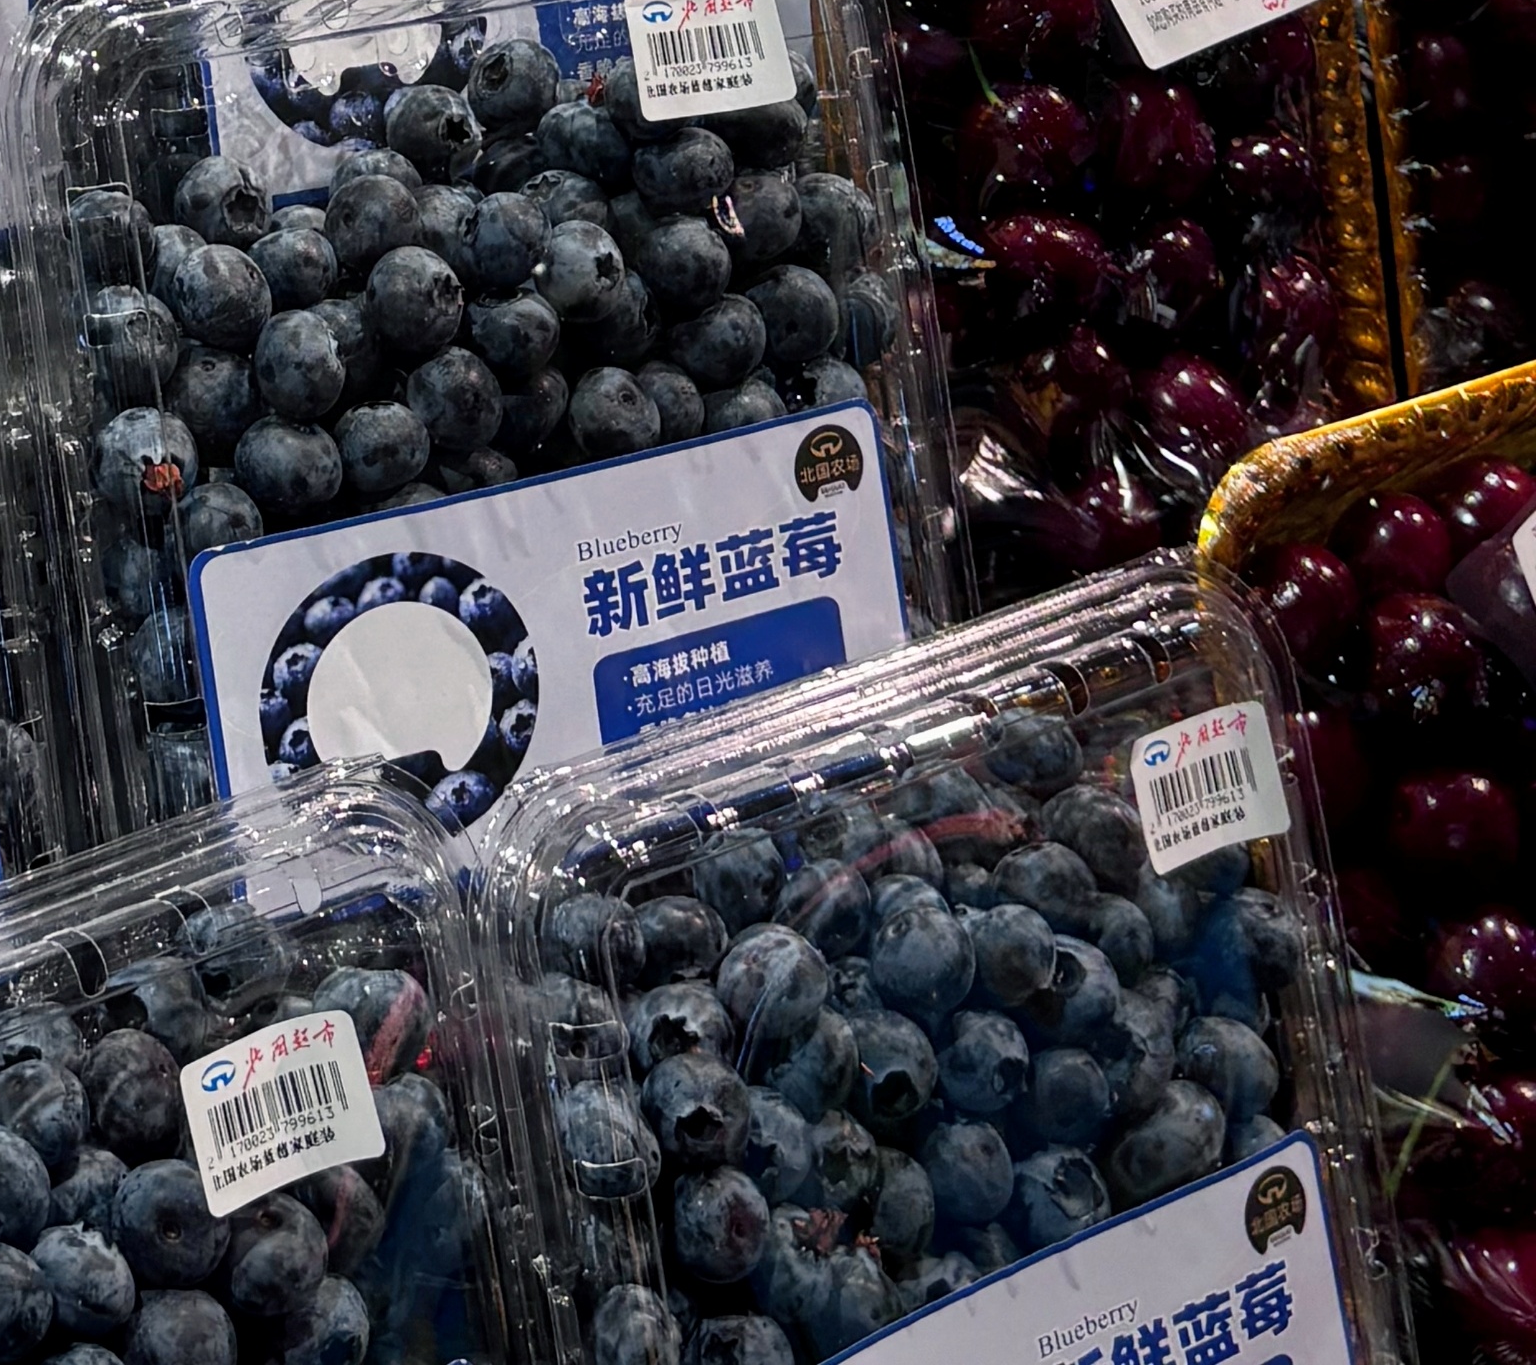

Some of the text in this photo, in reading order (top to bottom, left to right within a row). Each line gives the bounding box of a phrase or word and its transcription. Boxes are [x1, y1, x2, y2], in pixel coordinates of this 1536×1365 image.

[800, 455, 859, 485] 北国农场
[577, 523, 684, 562] Blueberry
[583, 511, 842, 638] 新鲜蓝莓
[630, 640, 731, 687] 高海拔种植
[635, 659, 775, 718] 充足的日光滋养
[208, 1157, 215, 1170] 2
[281, 1106, 336, 1132] 799613
[1038, 1300, 1139, 1359] Blueberry
